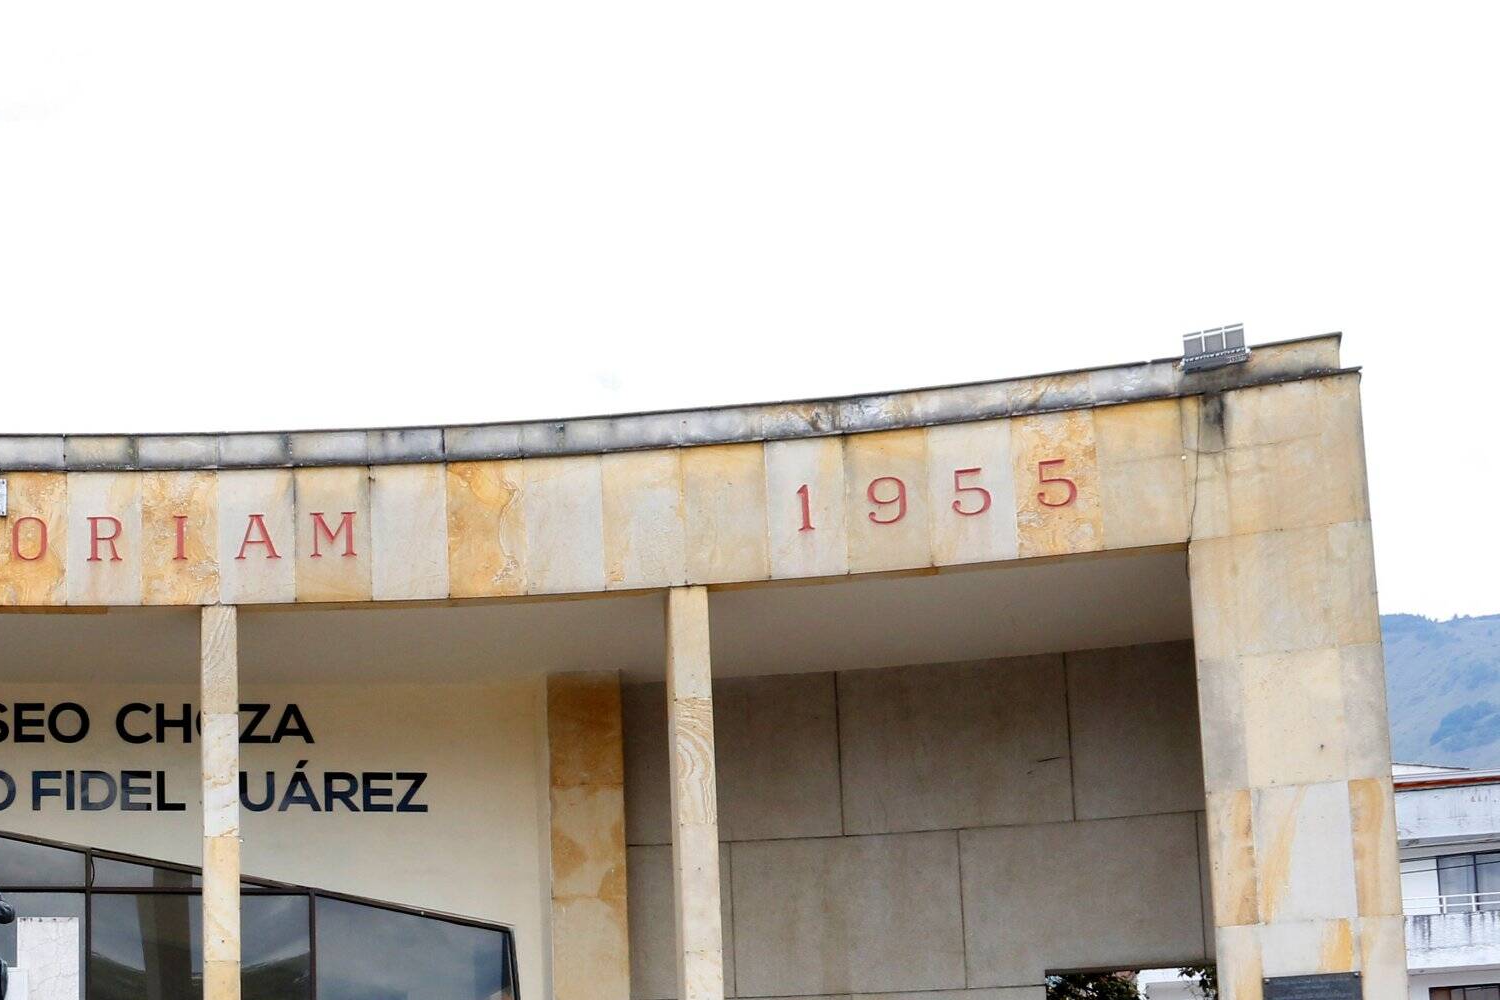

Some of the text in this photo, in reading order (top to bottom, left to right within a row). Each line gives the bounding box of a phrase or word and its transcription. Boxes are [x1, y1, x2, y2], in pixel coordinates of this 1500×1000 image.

[796, 459, 1078, 532] 1955
[116, 702, 315, 744] CHZA
[31, 770, 186, 812] FIDEL
[238, 760, 429, 812] UÁREZ
